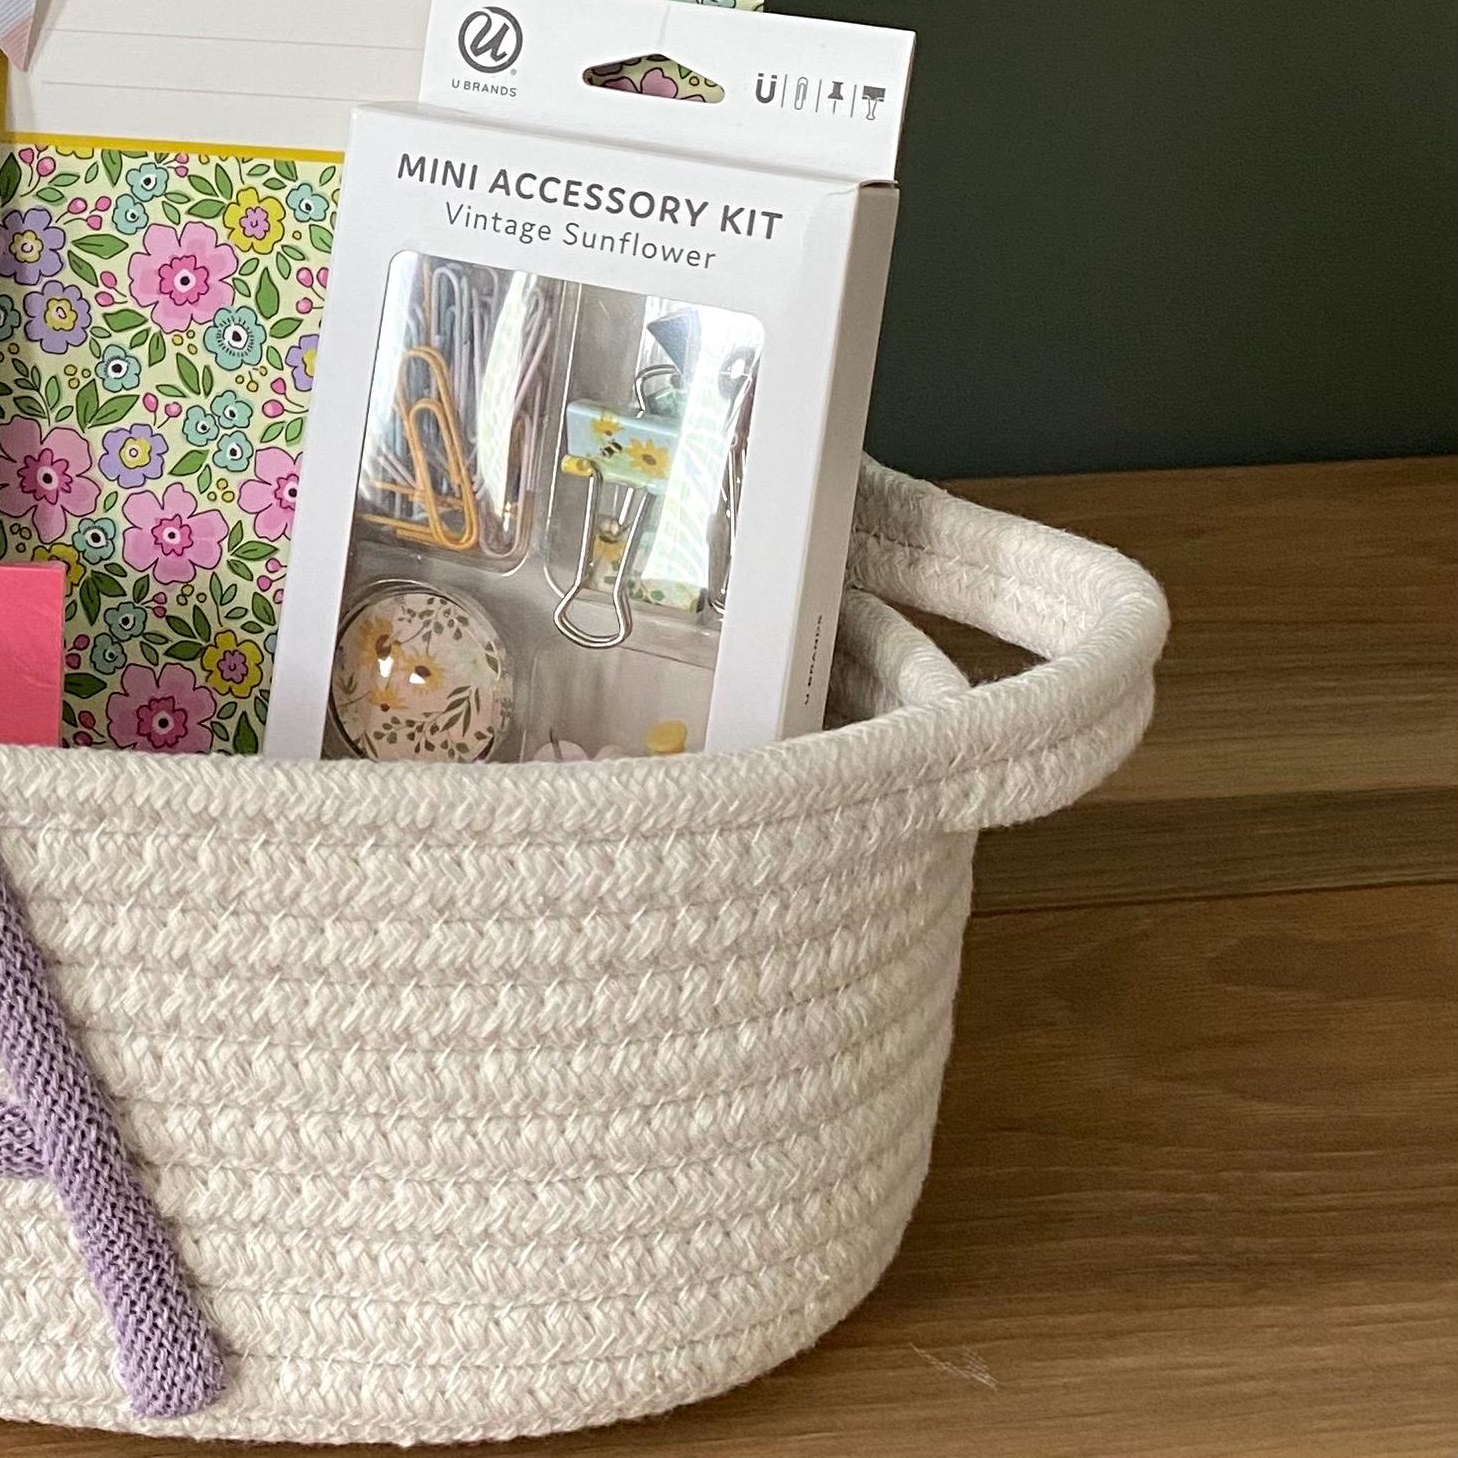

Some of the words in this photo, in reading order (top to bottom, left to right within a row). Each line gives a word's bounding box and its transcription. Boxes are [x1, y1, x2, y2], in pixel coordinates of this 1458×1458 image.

[452, 78, 460, 89] U
[463, 80, 517, 98] BRANDS
[397, 152, 479, 191] MINI
[489, 168, 709, 227] ACCESSORY
[720, 204, 783, 240] KIT
[446, 200, 552, 244] Vintage
[562, 222, 717, 270] Sunflower
